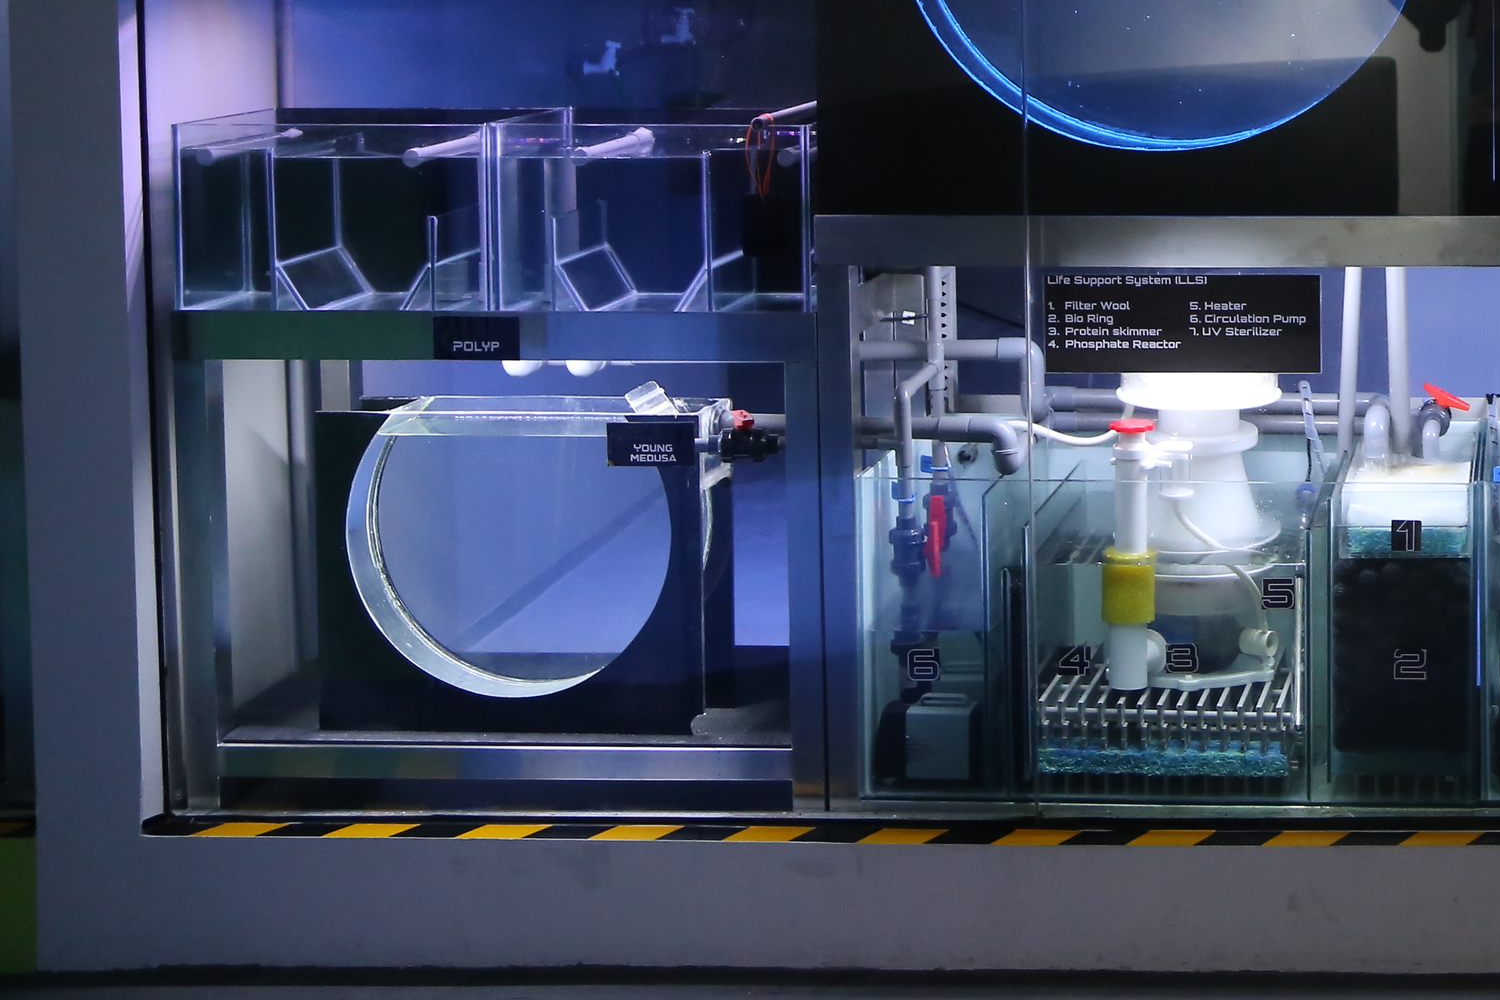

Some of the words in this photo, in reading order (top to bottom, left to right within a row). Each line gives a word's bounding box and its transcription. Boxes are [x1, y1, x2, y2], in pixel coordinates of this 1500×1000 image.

[1048, 275, 1070, 284] Life
[1074, 276, 1122, 286] Support
[1125, 276, 1171, 286] System
[1048, 302, 1054, 310] 1.
[1065, 301, 1097, 310] Filter
[1101, 301, 1130, 310] Wool
[1190, 302, 1201, 310] 5.
[1205, 302, 1246, 310] Heater
[1048, 314, 1059, 322] 2.
[1065, 314, 1083, 322] Bio
[1087, 314, 1113, 325] Ring
[1190, 315, 1201, 323] 6.
[1205, 314, 1269, 323] Circulation
[1273, 315, 1306, 325] Pump
[1048, 327, 1059, 335] 3.
[1065, 327, 1109, 335] Protein
[1113, 327, 1162, 336] skimmer
[1189, 328, 1199, 336] 7.
[1203, 327, 1221, 336] UV
[1226, 327, 1282, 336] Sterilizer
[453, 341, 499, 351] POLYP
[1048, 340, 1059, 348] 4.
[1066, 339, 1129, 350] Phosphate
[1133, 340, 1181, 348] Reactor
[633, 444, 674, 453] YOUNG
[631, 454, 676, 462] MEDUSA
[1396, 520, 1420, 551] 1
[1262, 578, 1295, 610] 5
[1058, 647, 1091, 676] 4
[1166, 644, 1199, 674] 3
[1393, 648, 1428, 681] 2
[906, 649, 940, 681] 6
